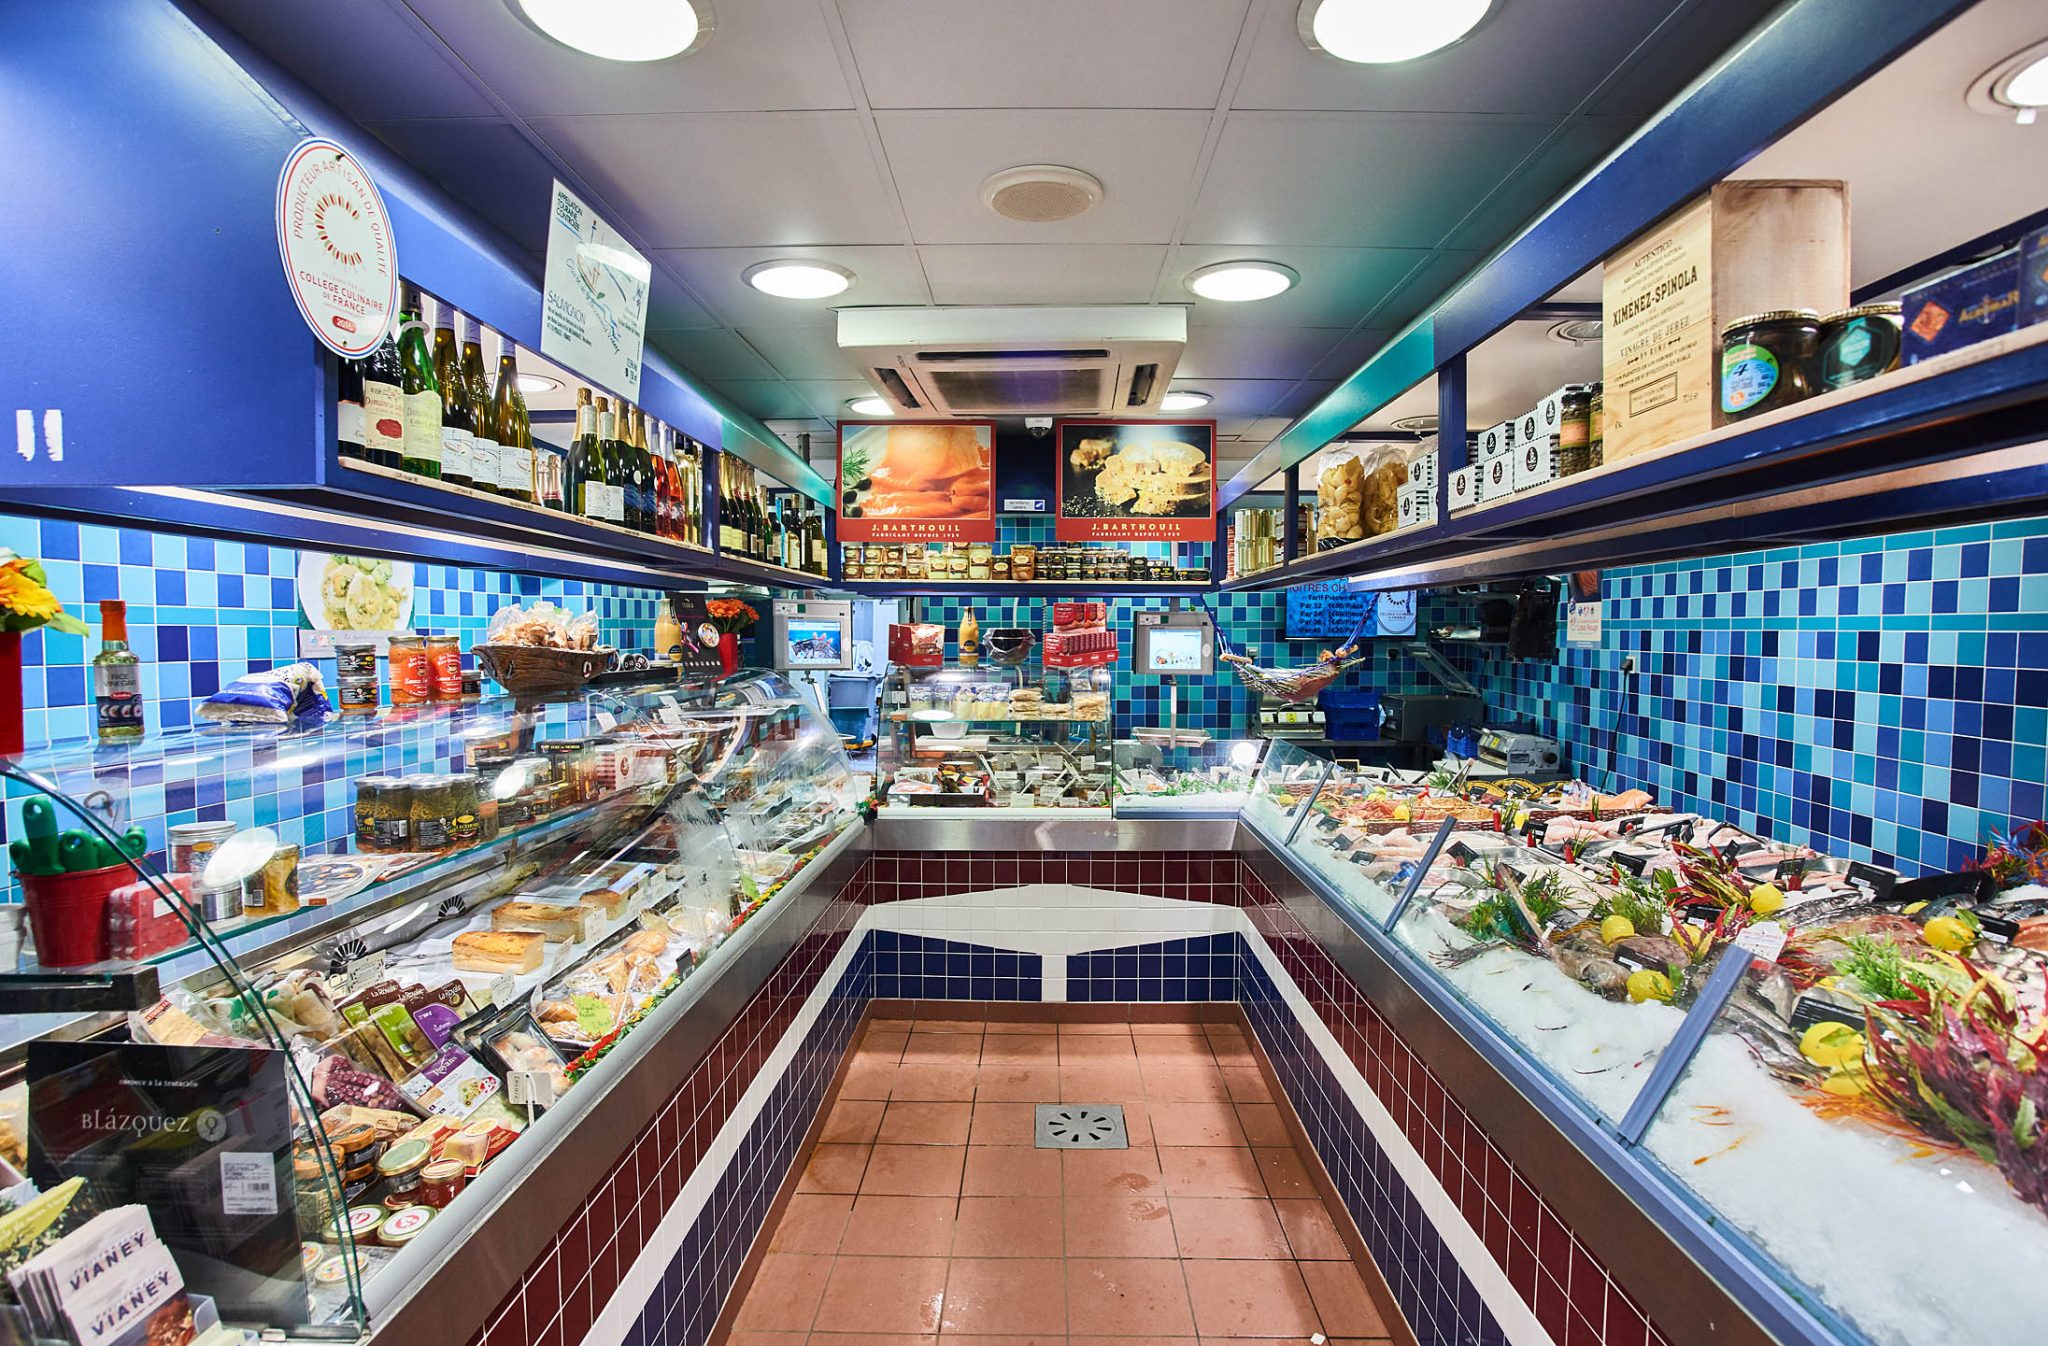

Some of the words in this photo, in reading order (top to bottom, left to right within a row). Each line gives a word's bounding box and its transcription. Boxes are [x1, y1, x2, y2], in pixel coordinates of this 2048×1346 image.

[294, 163, 320, 239] PRODUCTEUR
[322, 160, 365, 204] ARTISAN
[333, 294, 366, 316] FRANCE
[341, 287, 384, 313] CULINAIRE
[70, 1232, 144, 1291] VIANEY
[92, 1271, 169, 1336] VIANEY
